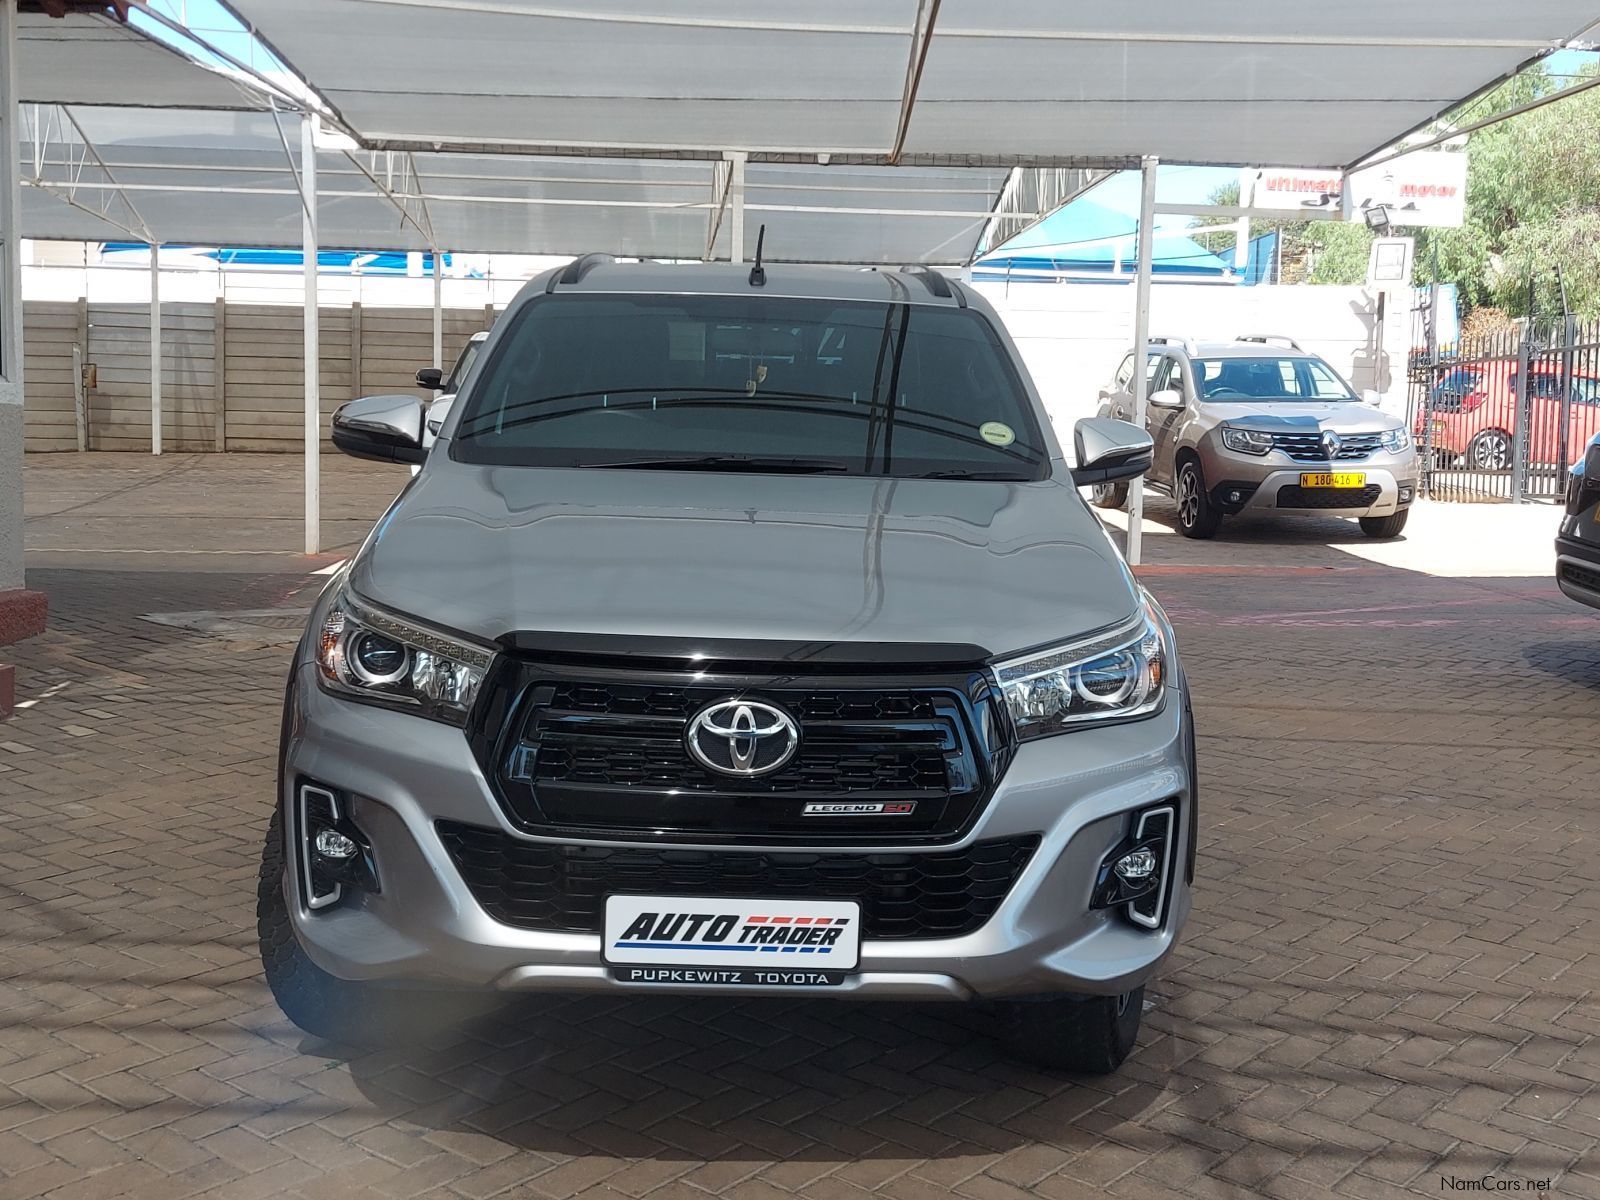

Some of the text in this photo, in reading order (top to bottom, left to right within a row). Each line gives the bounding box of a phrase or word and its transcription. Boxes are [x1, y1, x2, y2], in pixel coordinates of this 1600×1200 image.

[1302, 475, 1308, 486] N
[1357, 475, 1363, 485] W
[882, 804, 911, 813] 50
[619, 912, 844, 946] AUTO TRADER
[631, 969, 829, 984] PUPKEWITZ TOYOTA
